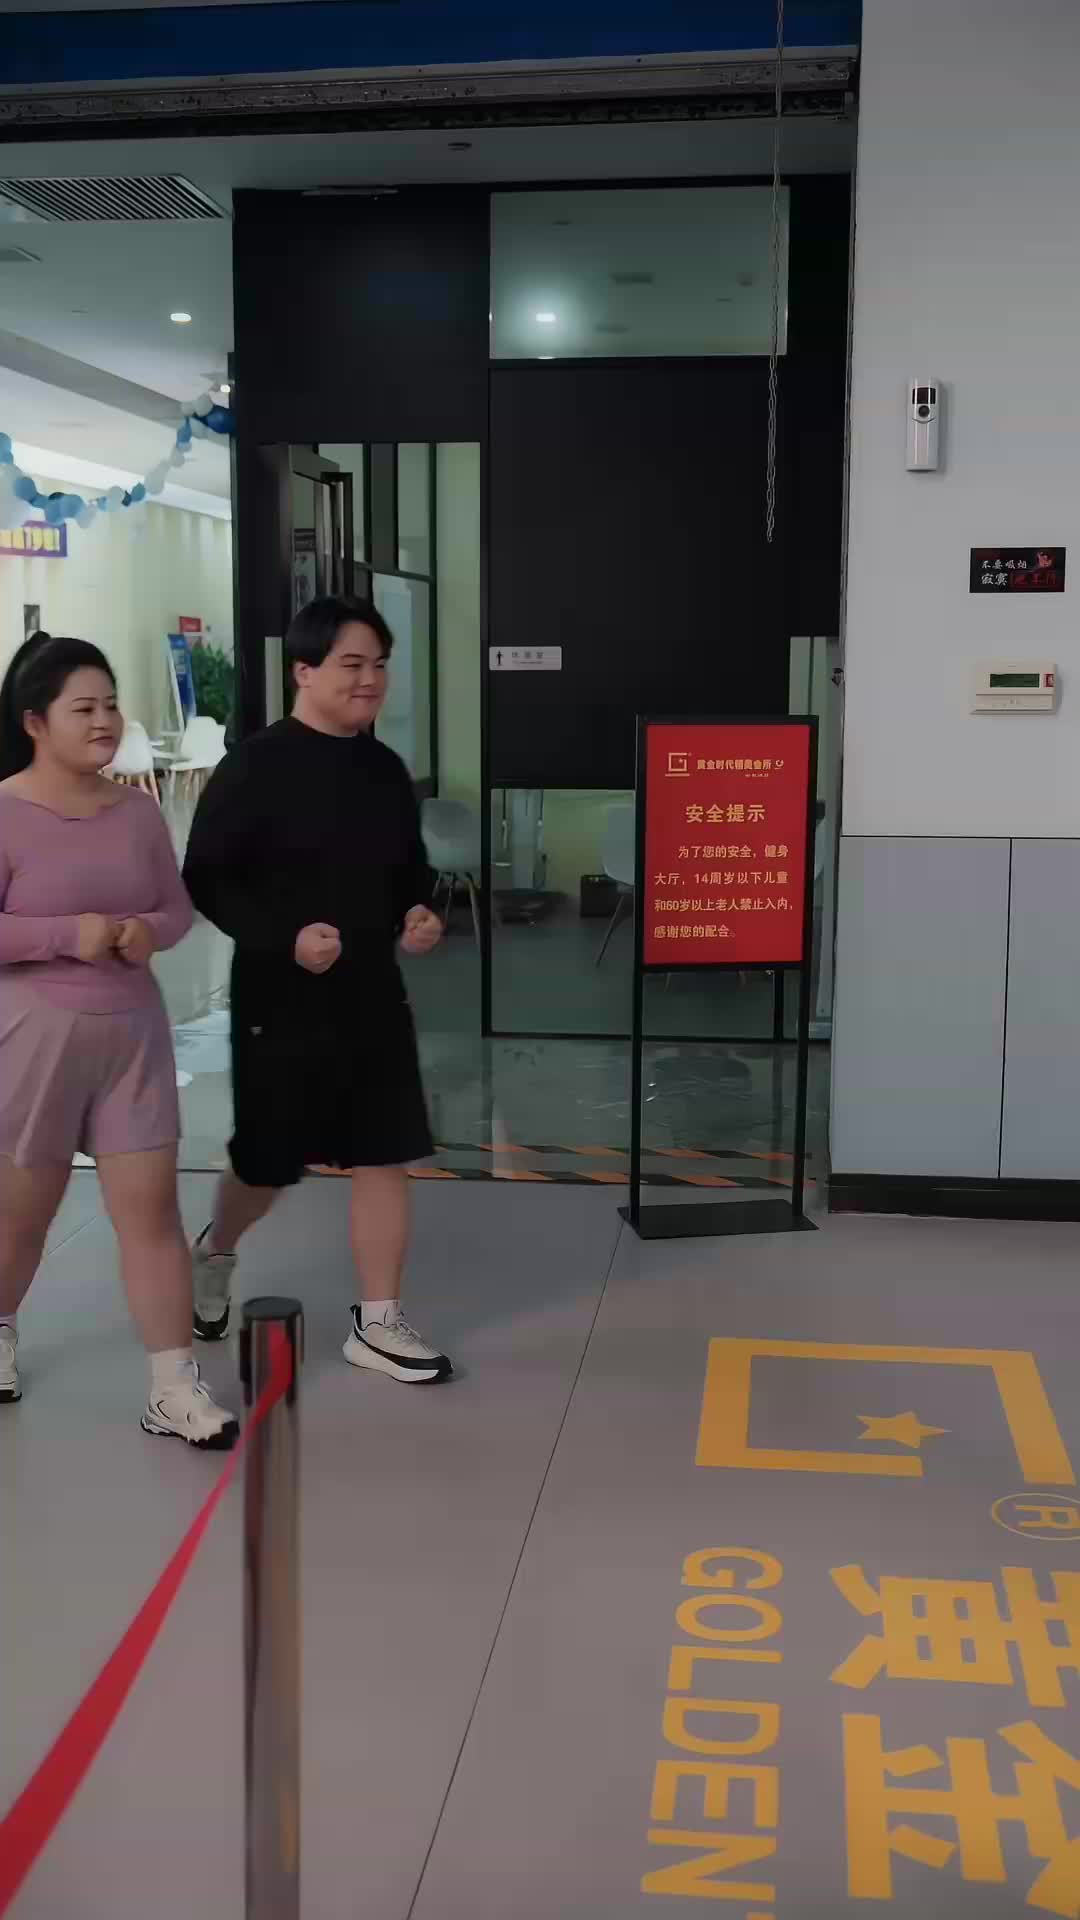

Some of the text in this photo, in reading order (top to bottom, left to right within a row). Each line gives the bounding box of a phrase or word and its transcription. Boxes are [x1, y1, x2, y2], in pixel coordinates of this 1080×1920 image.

[685, 803, 766, 823] 安全提示
[678, 843, 789, 859] 为了您的安全，健身
[653, 871, 789, 886] 大厅，14周岁以下儿童
[640, 1546, 784, 1902] GOLDEN
